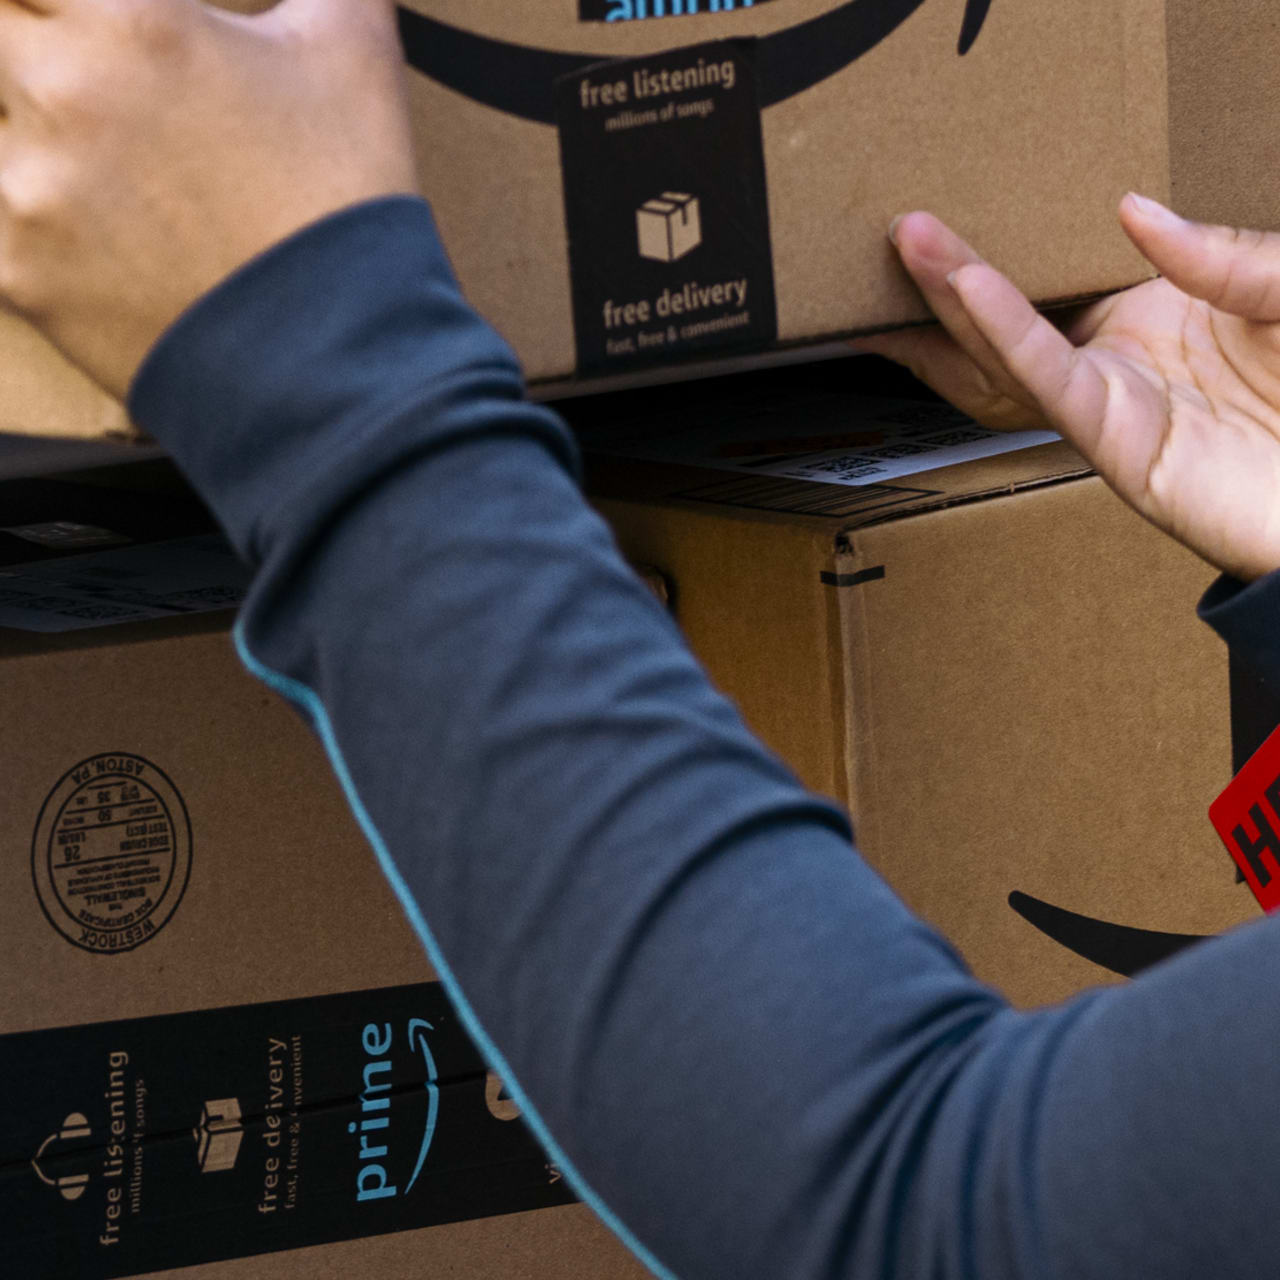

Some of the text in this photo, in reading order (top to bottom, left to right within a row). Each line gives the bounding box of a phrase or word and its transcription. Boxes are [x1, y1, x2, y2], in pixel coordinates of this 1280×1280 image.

[578, 57, 737, 109] free listening
[604, 98, 715, 132] millions of songs
[602, 277, 749, 330] free delivery
[77, 920, 157, 949] WESTROCK
[136, 1078, 148, 1128] songs
[257, 1036, 288, 1214] free deivery
[347, 1021, 398, 1203] prime
[99, 1050, 129, 1247] free lisening
[130, 1146, 144, 1214] millions
